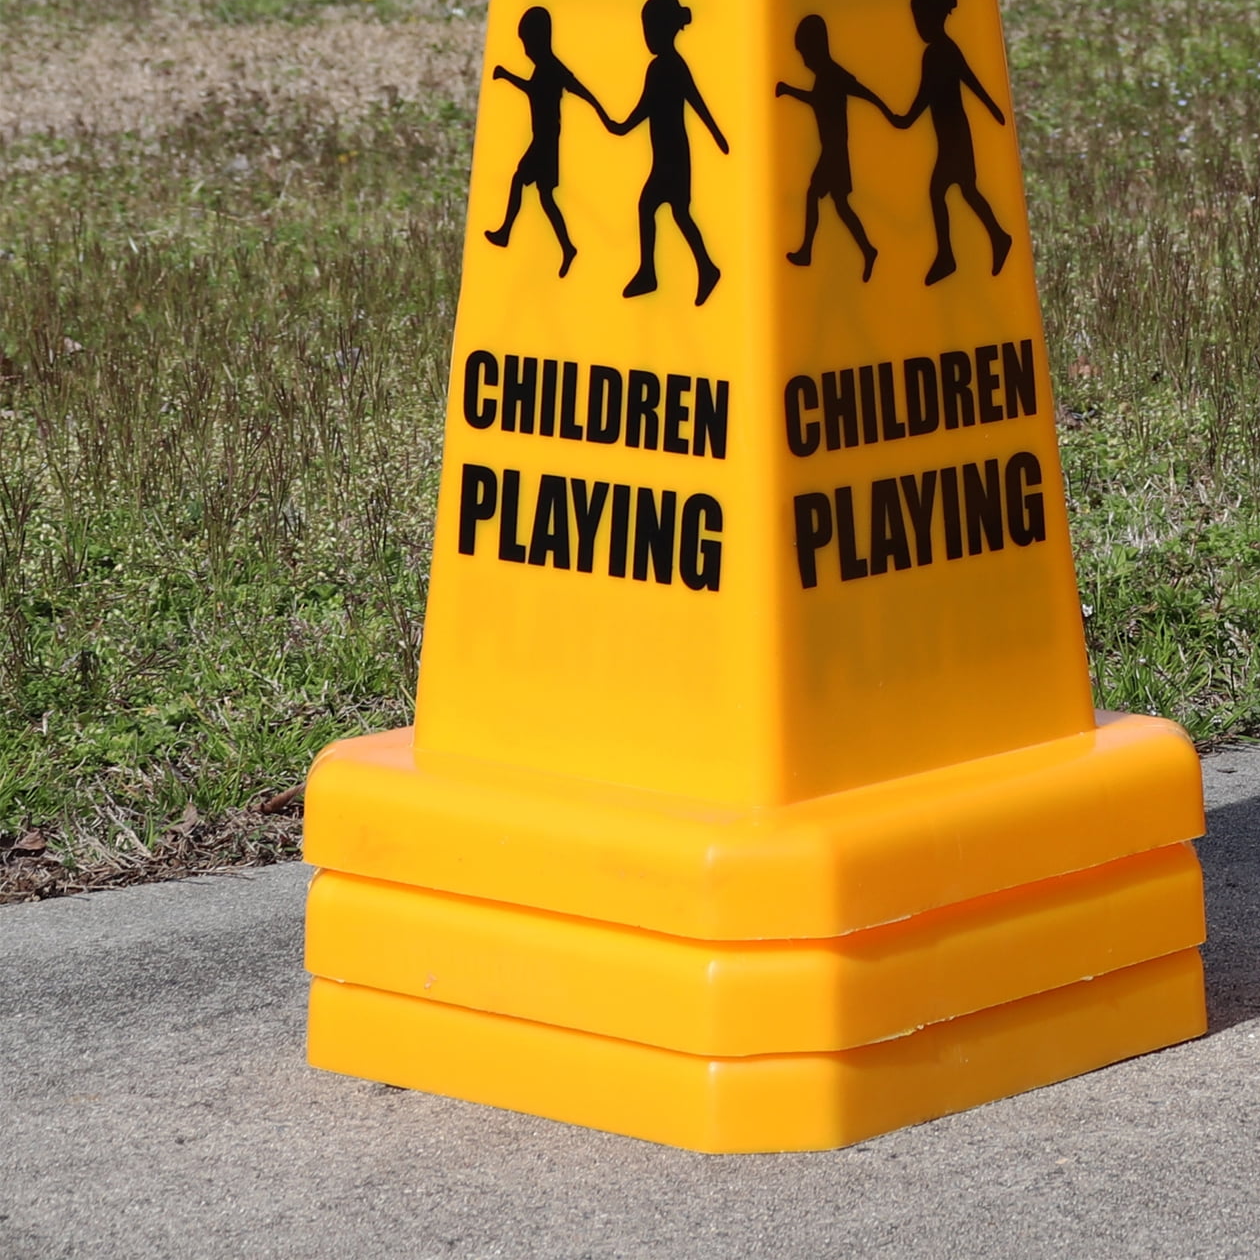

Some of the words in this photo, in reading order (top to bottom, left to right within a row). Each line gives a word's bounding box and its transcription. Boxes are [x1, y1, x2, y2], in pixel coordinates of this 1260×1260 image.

[463, 350, 729, 459] CHILDREN
[784, 339, 1037, 458] CHILDREN
[458, 463, 723, 592] PLAYING
[793, 451, 1046, 589] PLAYING
